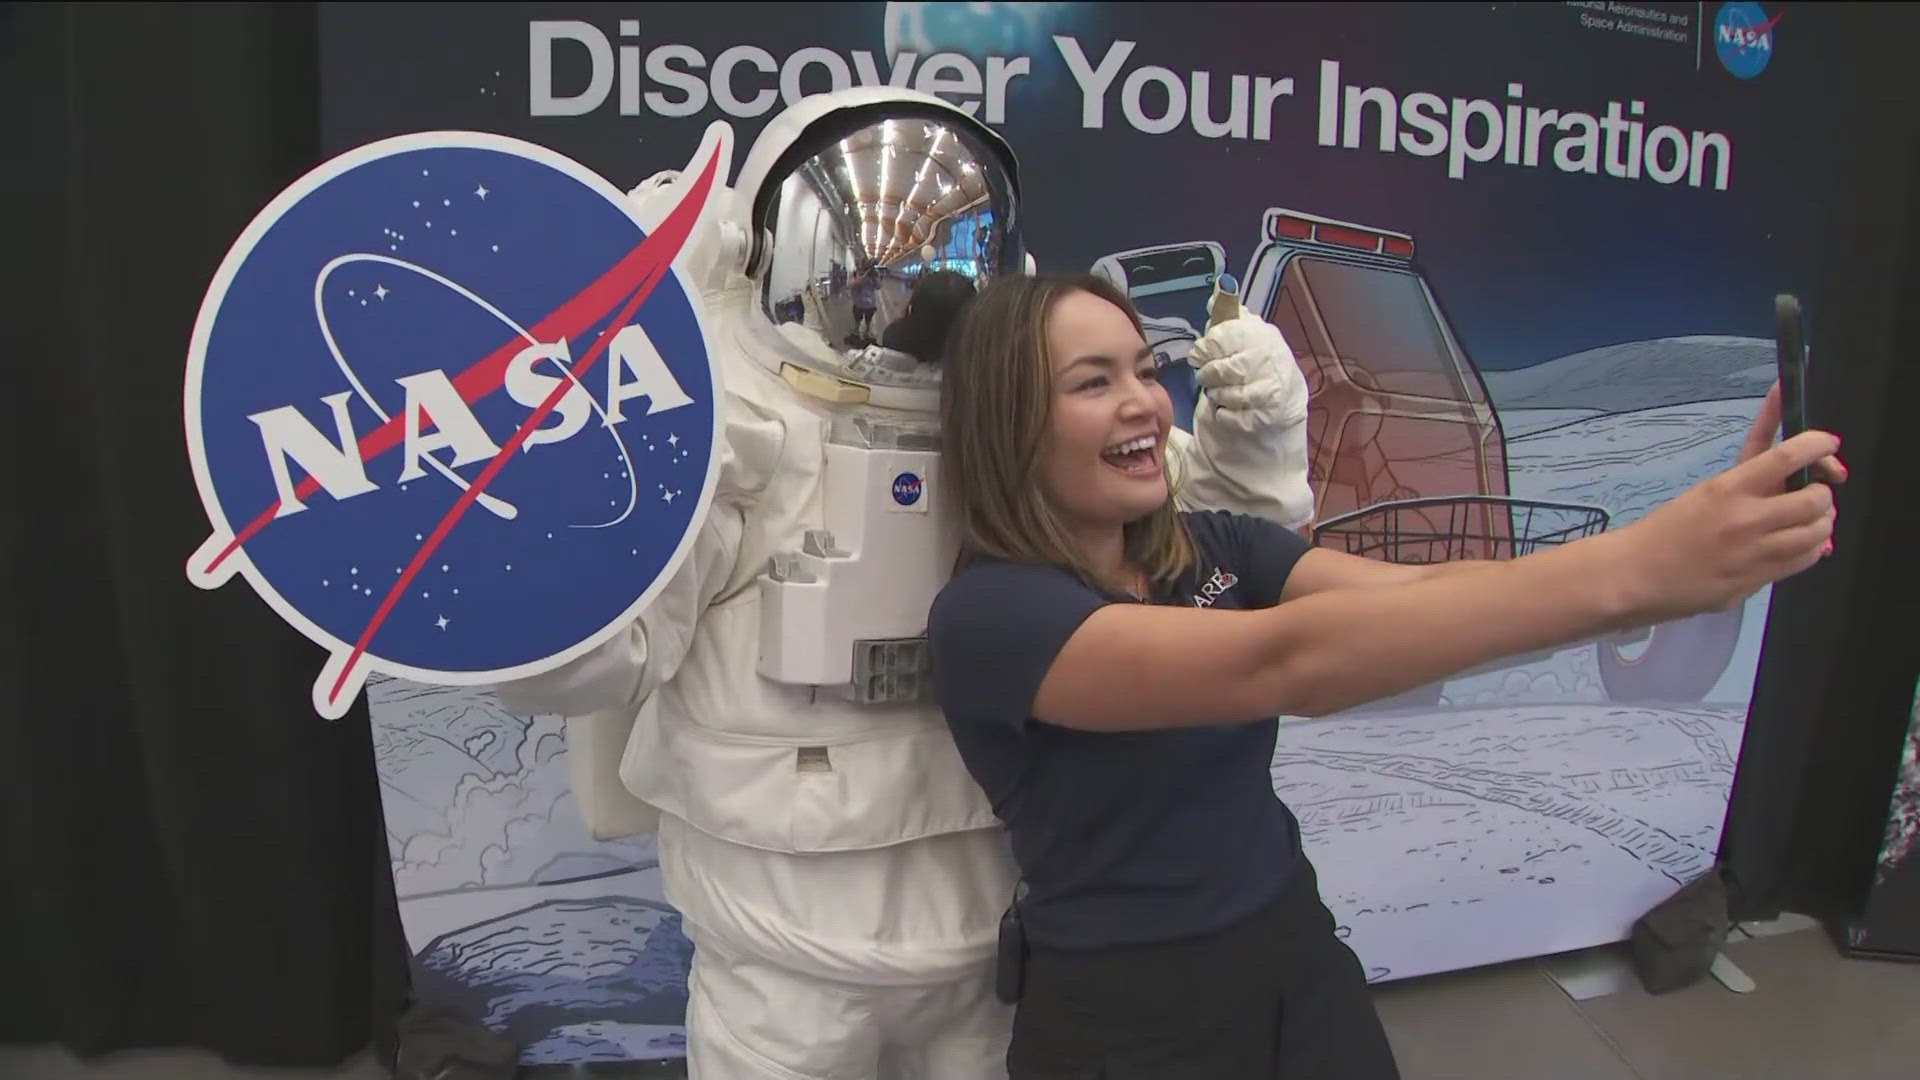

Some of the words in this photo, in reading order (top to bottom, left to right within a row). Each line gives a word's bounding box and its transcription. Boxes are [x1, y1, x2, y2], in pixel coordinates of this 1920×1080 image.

[1580, 13, 1614, 30] Space
[1616, 19, 1688, 43] Administration
[1607, 2, 1668, 22] Aeronautics
[1669, 14, 1689, 26] and
[1719, 24, 1769, 51] NASA
[529, 19, 1030, 124] Discover
[1052, 34, 1294, 141] Your
[1317, 59, 1732, 191] Inspiration
[246, 322, 695, 520] NASA
[1193, 570, 1227, 610] ARE
